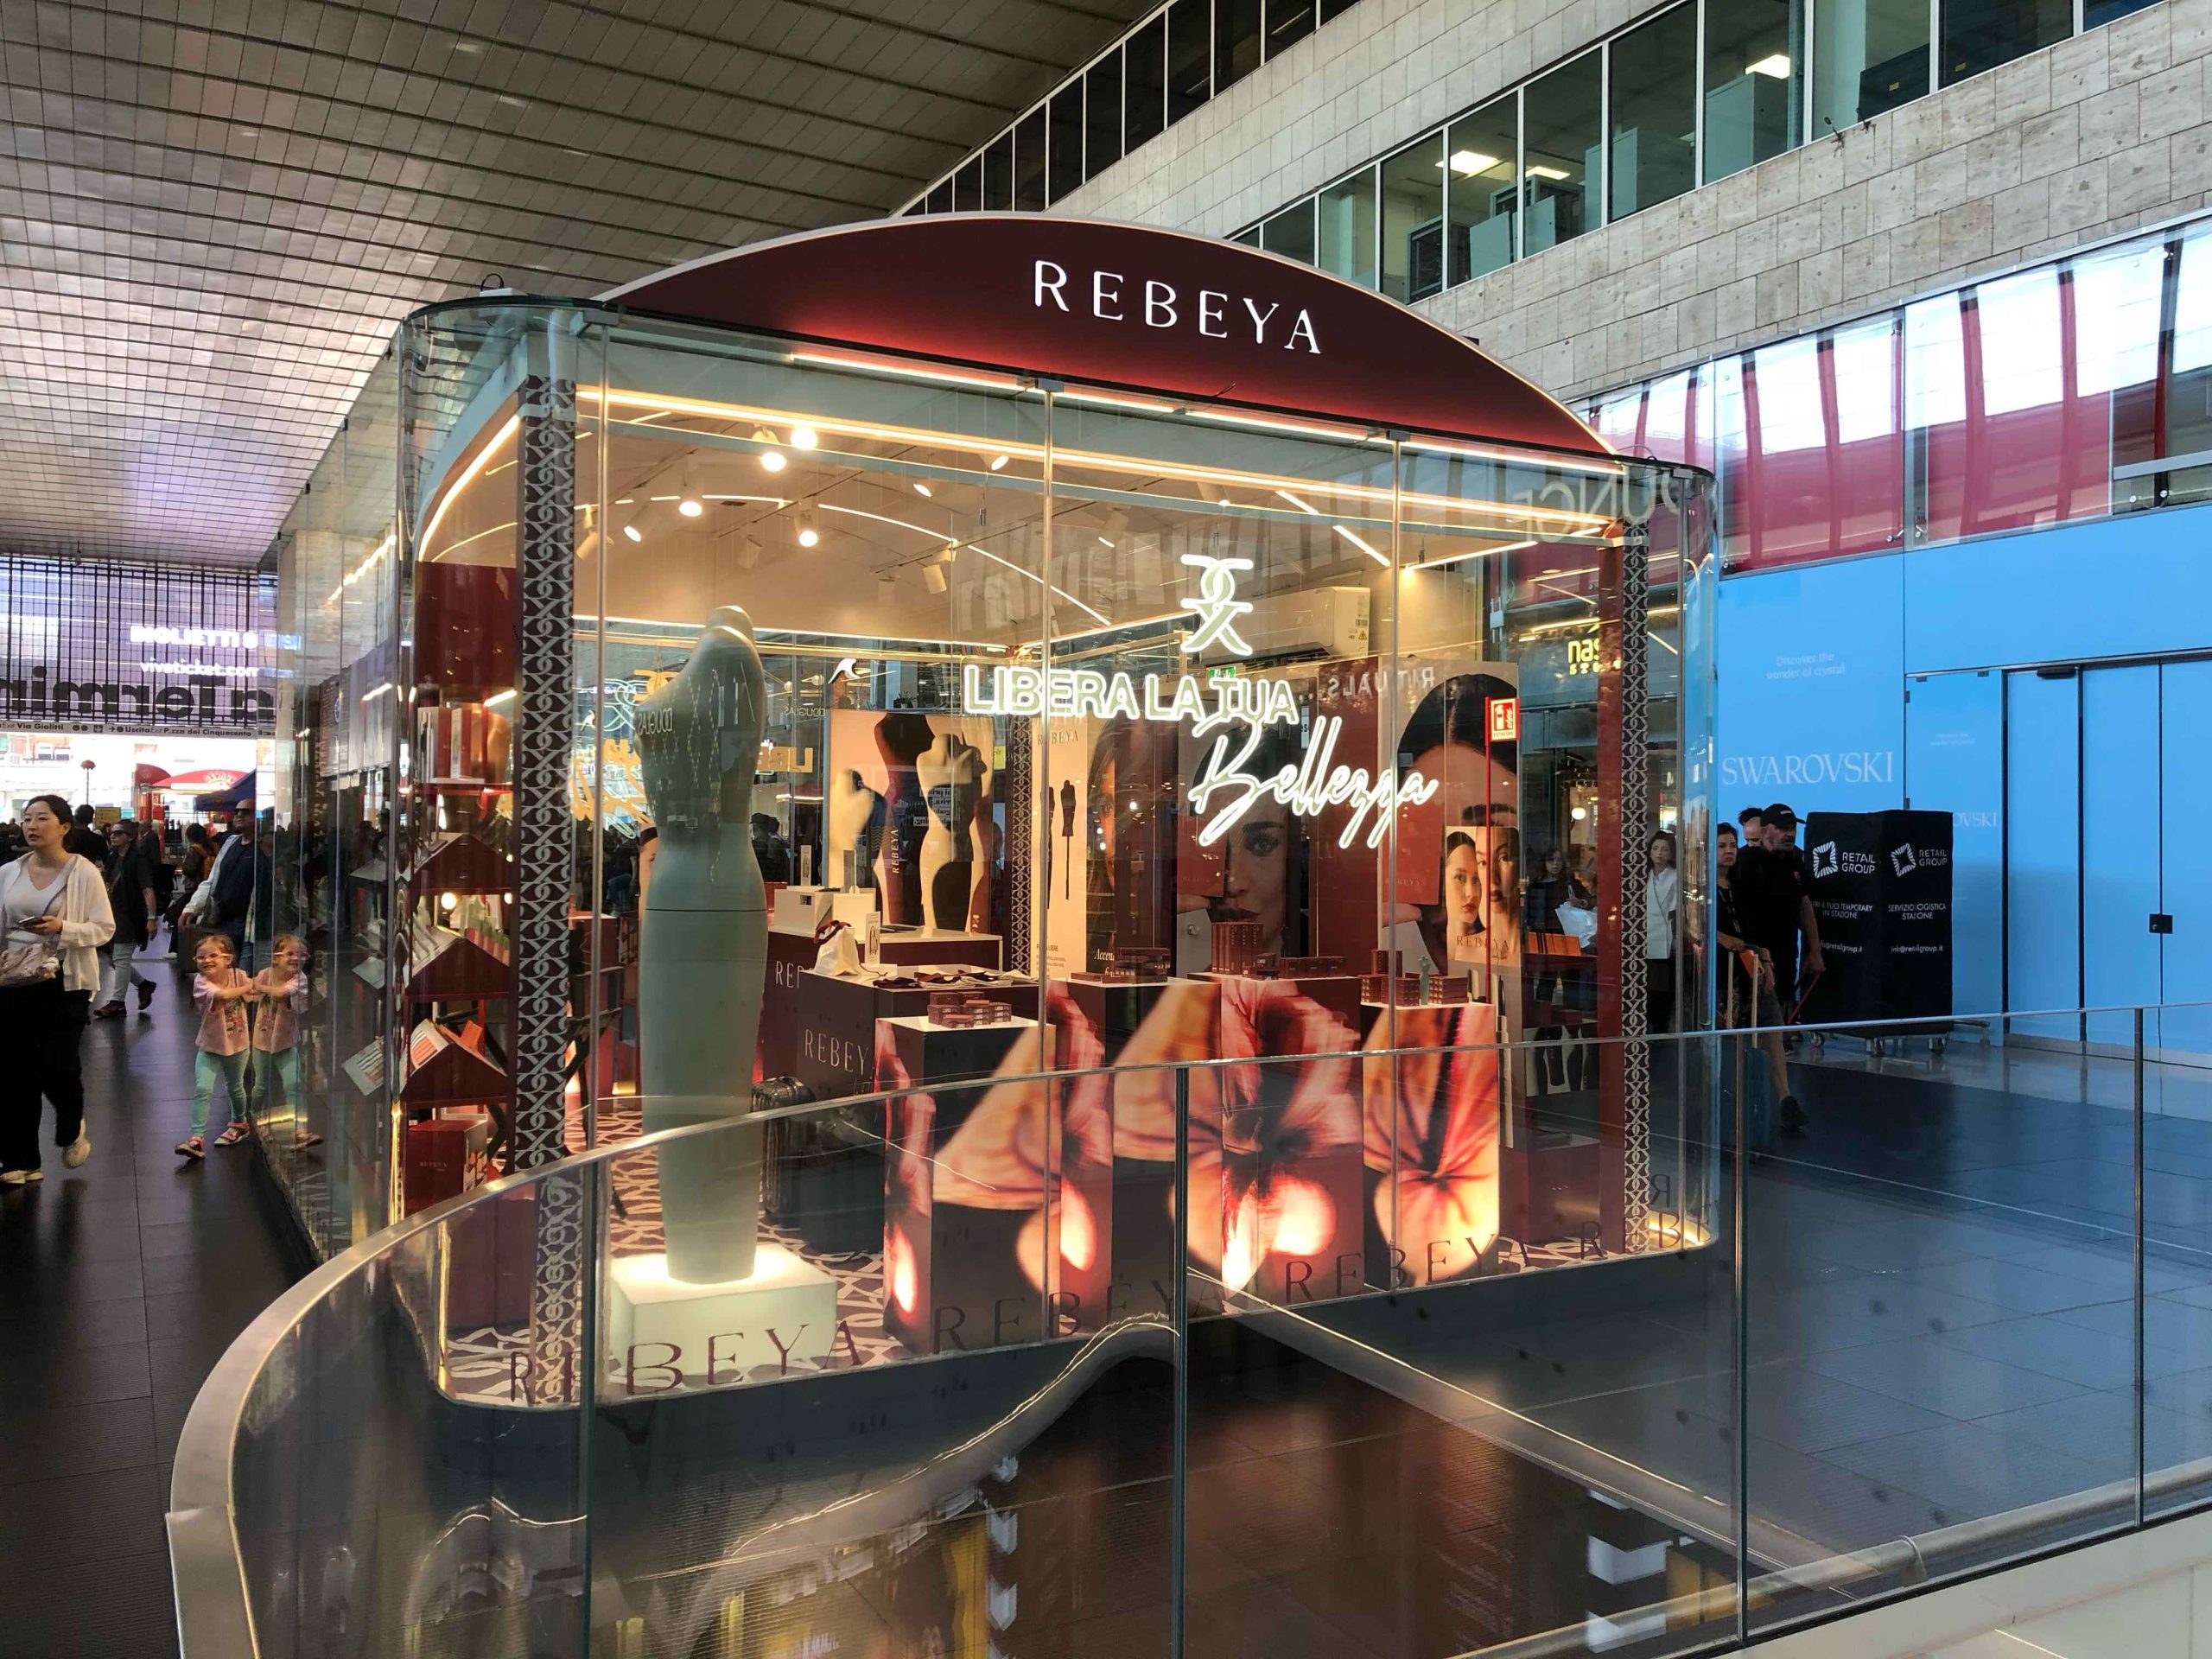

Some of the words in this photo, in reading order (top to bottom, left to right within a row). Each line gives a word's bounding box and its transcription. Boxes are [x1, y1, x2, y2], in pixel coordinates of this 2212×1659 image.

[1033, 259, 1321, 354] REBEYA
[1777, 655, 1815, 666] Discover
[1818, 651, 1834, 662] the
[1766, 669, 1799, 679] wonder
[1802, 667, 1812, 677] of
[1815, 663, 1845, 676] crystal
[963, 664, 1140, 720] LIBERA
[1145, 673, 1206, 722] LA
[1210, 677, 1300, 726] TUA
[35, 722, 64, 731] Giolitti
[202, 728, 252, 737] Cinquecento
[1038, 729, 1079, 746] RBEYA
[1722, 751, 1895, 785] SWAROVSKI
[1188, 714, 1440, 849] Bellezza
[892, 829, 900, 874] REBEYA
[1841, 851, 1876, 863] RETAIL
[1841, 863, 1876, 874] GROUP
[1888, 904, 1914, 912] SERVIZIO
[1456, 935, 1510, 951] REBYA
[1285, 1231, 1531, 1303] REBEYA
